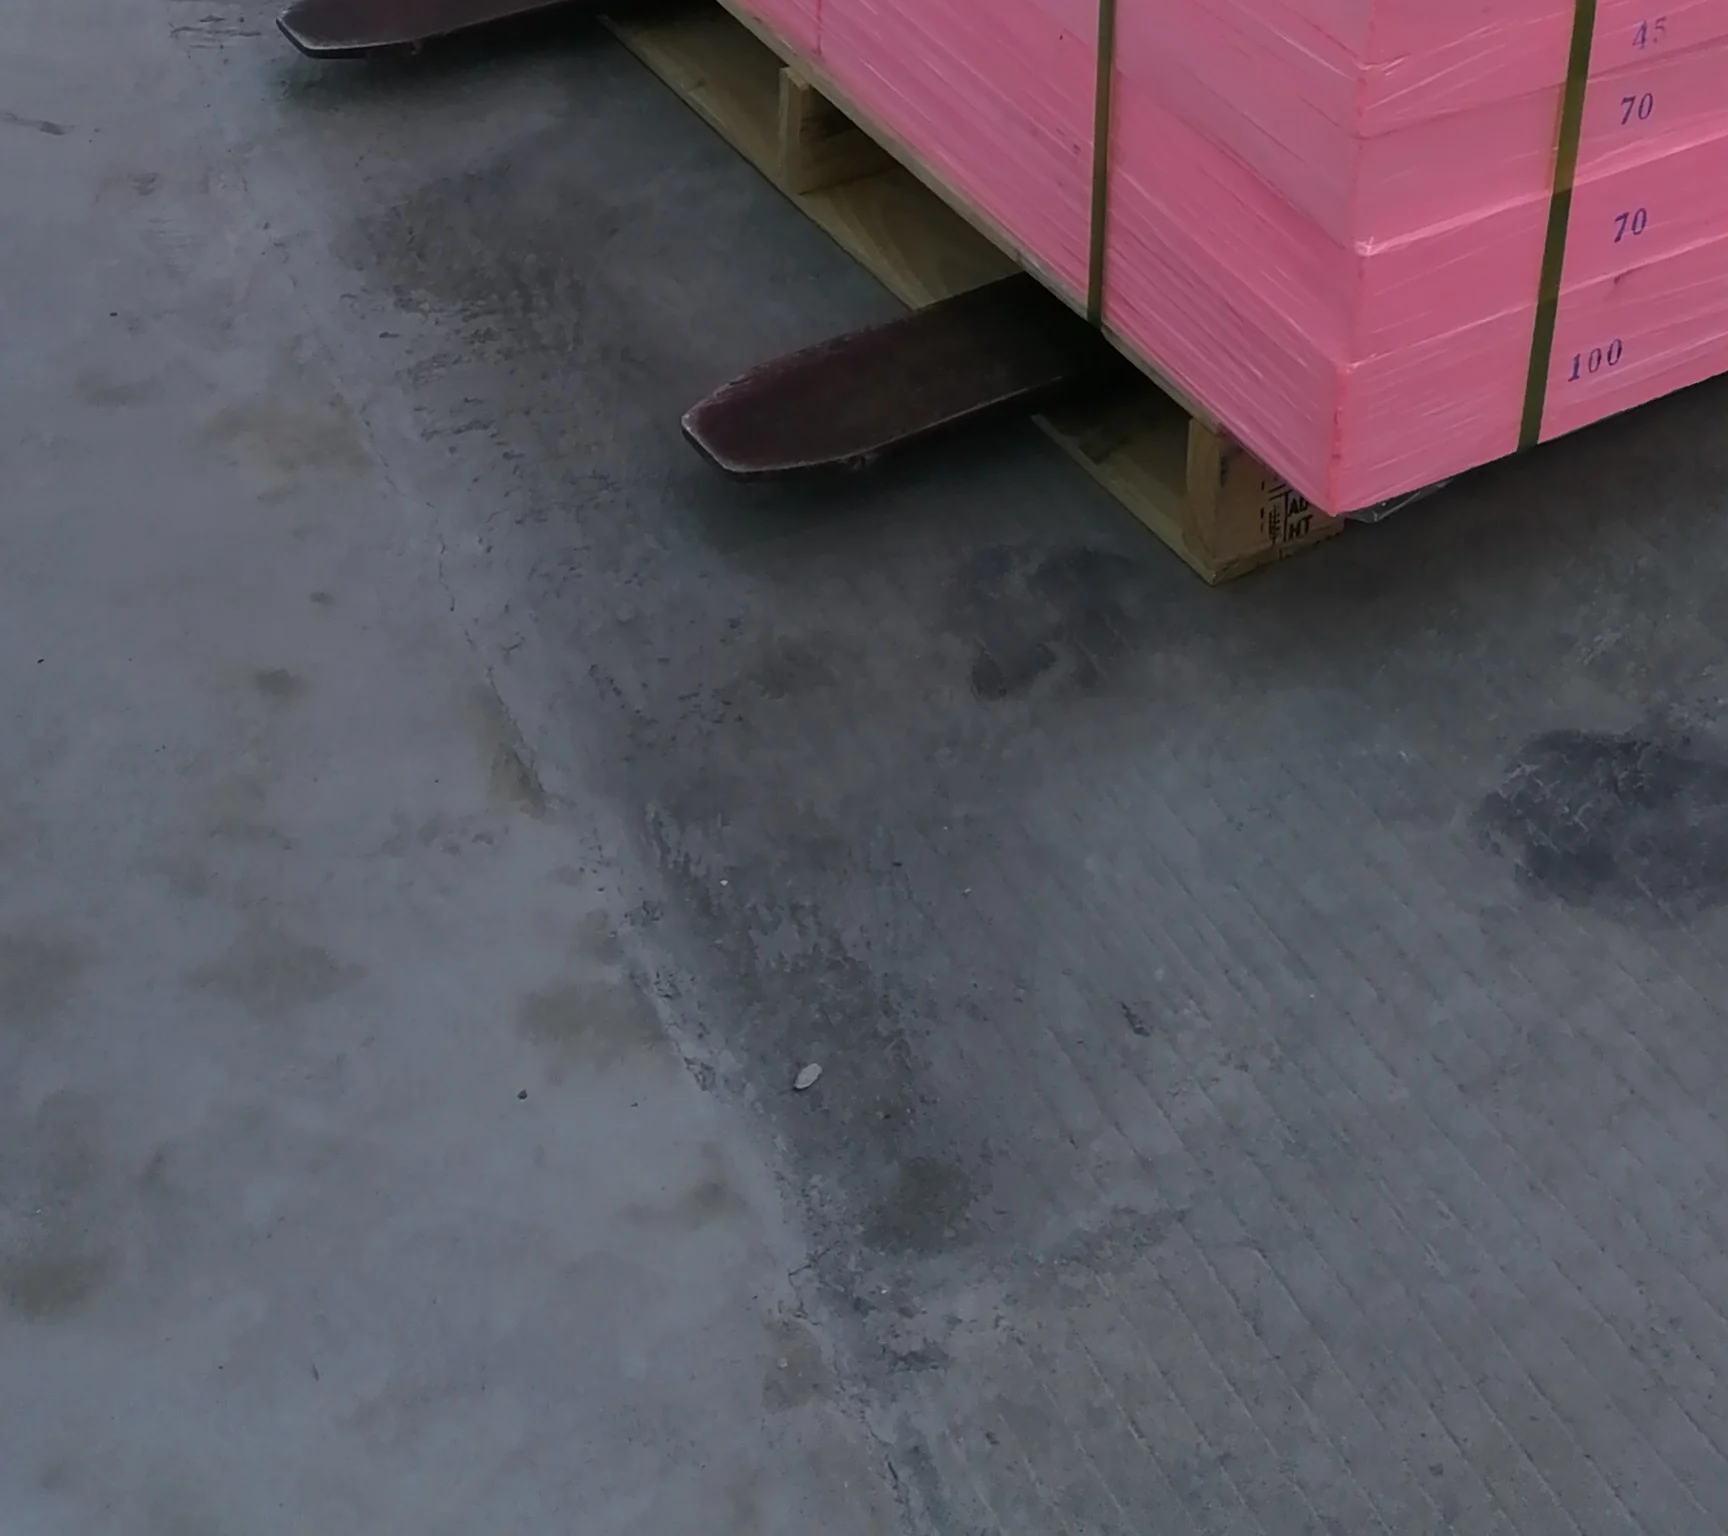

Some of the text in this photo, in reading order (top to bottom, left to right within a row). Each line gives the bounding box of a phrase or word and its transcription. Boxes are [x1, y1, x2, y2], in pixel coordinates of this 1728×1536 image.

[1632, 17, 1667, 50] 45
[1620, 92, 1653, 126] 70
[1613, 208, 1647, 243] 70
[1568, 339, 1622, 382] 100
